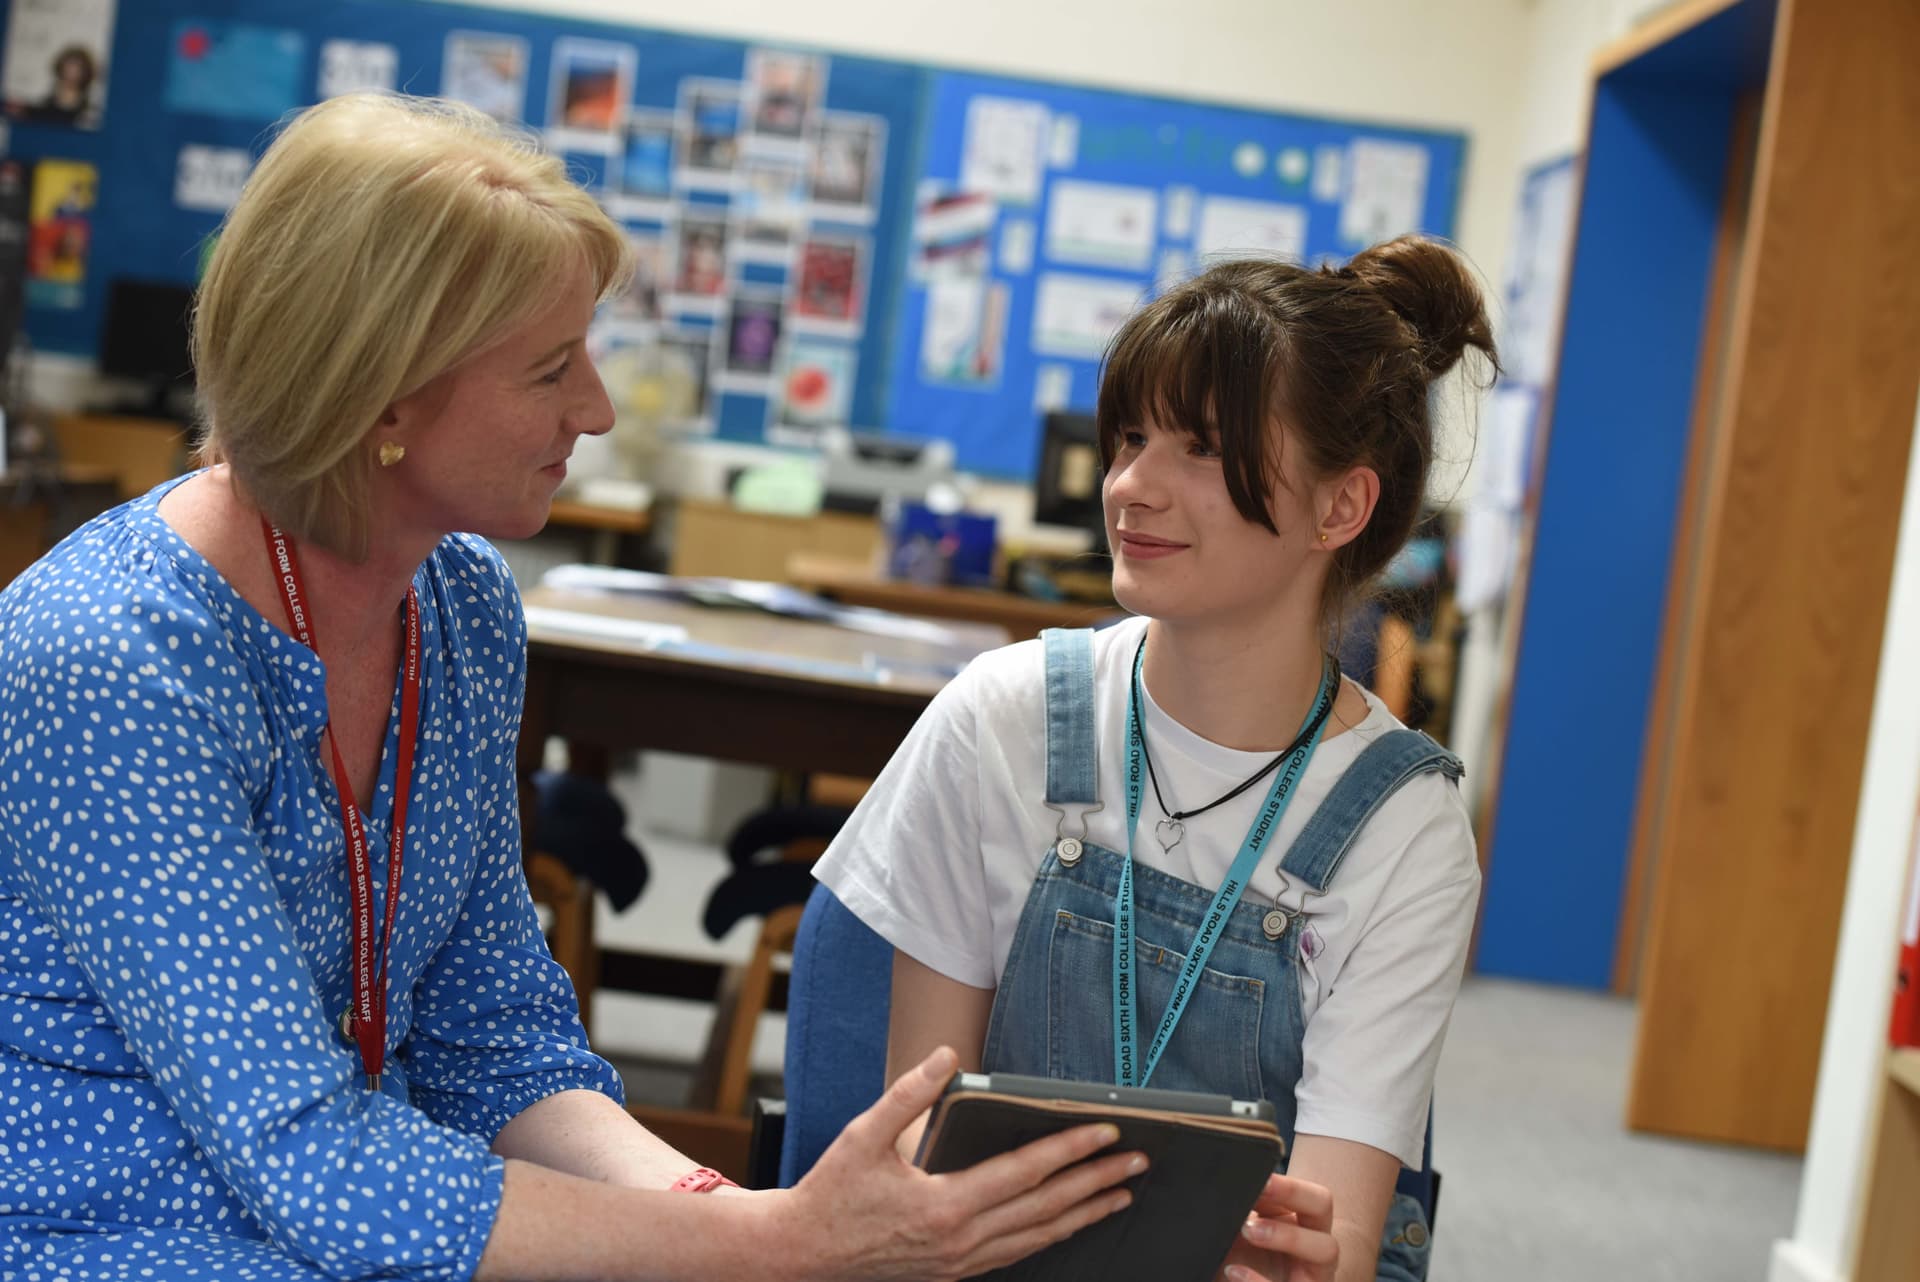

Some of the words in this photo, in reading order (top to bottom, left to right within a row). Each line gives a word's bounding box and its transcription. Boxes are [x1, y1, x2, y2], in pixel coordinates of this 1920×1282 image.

[274, 539, 291, 574] FORM
[284, 575, 306, 631] COLLEGE
[1130, 750, 1140, 780] ROAD
[1274, 749, 1306, 801] COLLEGE
[1130, 785, 1139, 818] HILLS
[348, 805, 359, 839] HILLS
[1250, 801, 1280, 852] STUDENT
[354, 840, 364, 872] ROAD
[394, 826, 402, 862] STAFF
[357, 874, 368, 908] SIXTH
[1216, 879, 1239, 912] HILLS
[360, 909, 368, 938] FORM
[1200, 911, 1222, 944] ROAD
[1119, 914, 1129, 970] COLLEGE
[360, 940, 369, 989] COLLEGE
[1185, 944, 1205, 978] SIXTH
[361, 990, 371, 1023] STAFF
[1119, 973, 1129, 1007] FORM
[1172, 978, 1190, 1011] FORM
[1120, 1009, 1131, 1042] SIXTH
[1149, 1011, 1175, 1060] COLLEGE
[1121, 1045, 1132, 1080] ROAD
